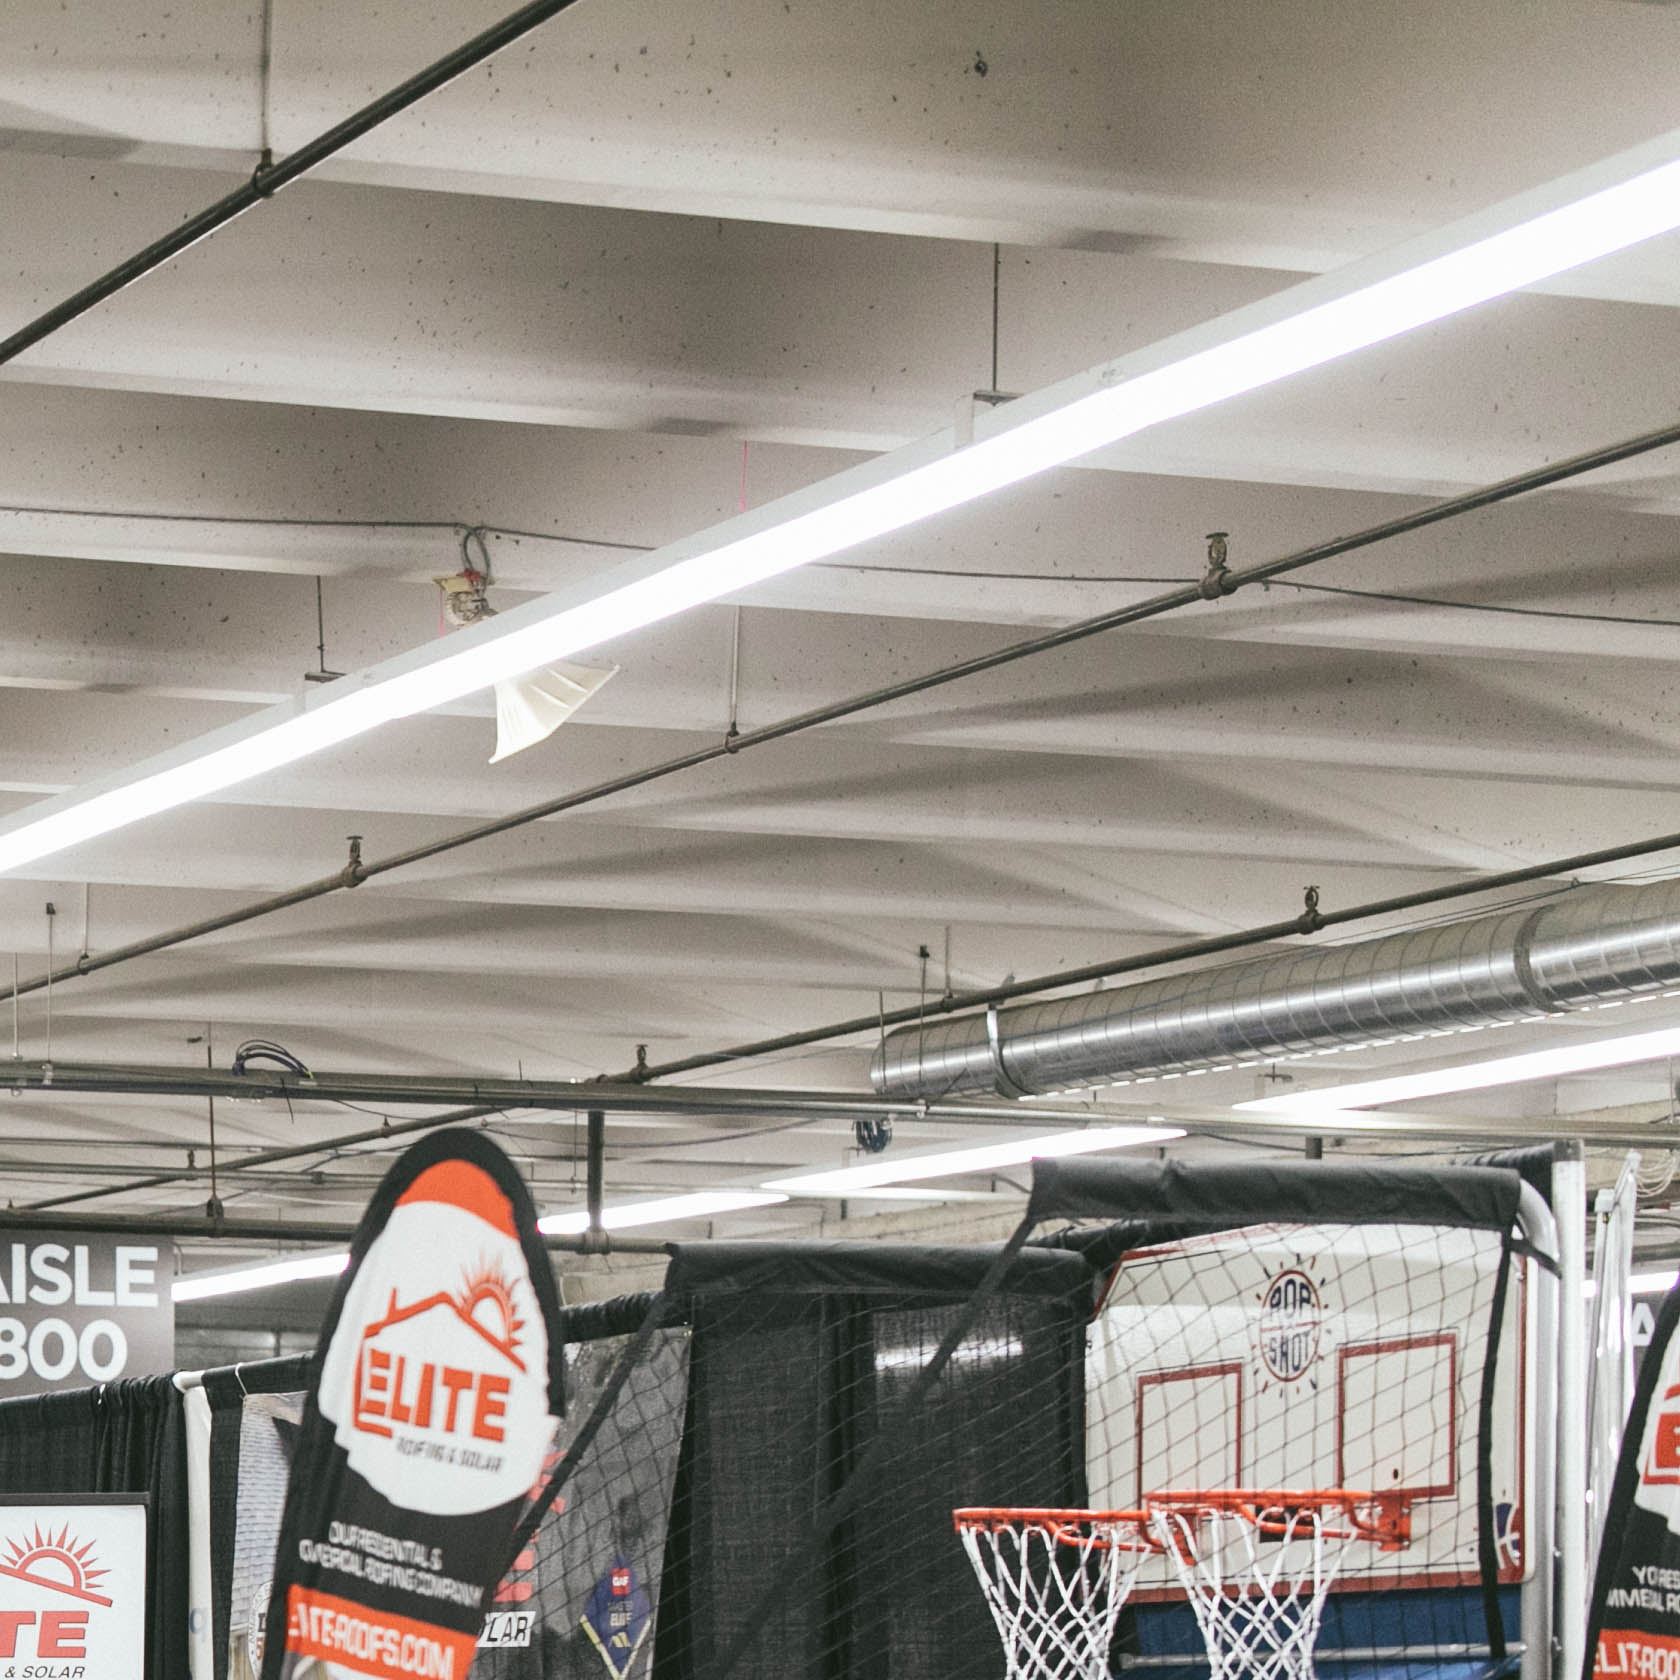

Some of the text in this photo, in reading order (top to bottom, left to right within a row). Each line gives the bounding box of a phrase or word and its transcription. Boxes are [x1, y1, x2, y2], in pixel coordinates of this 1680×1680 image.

[356, 1348, 511, 1444] ELITE
[5, 1665, 15, 1679] &
[22, 1665, 86, 1679] SOLAR
